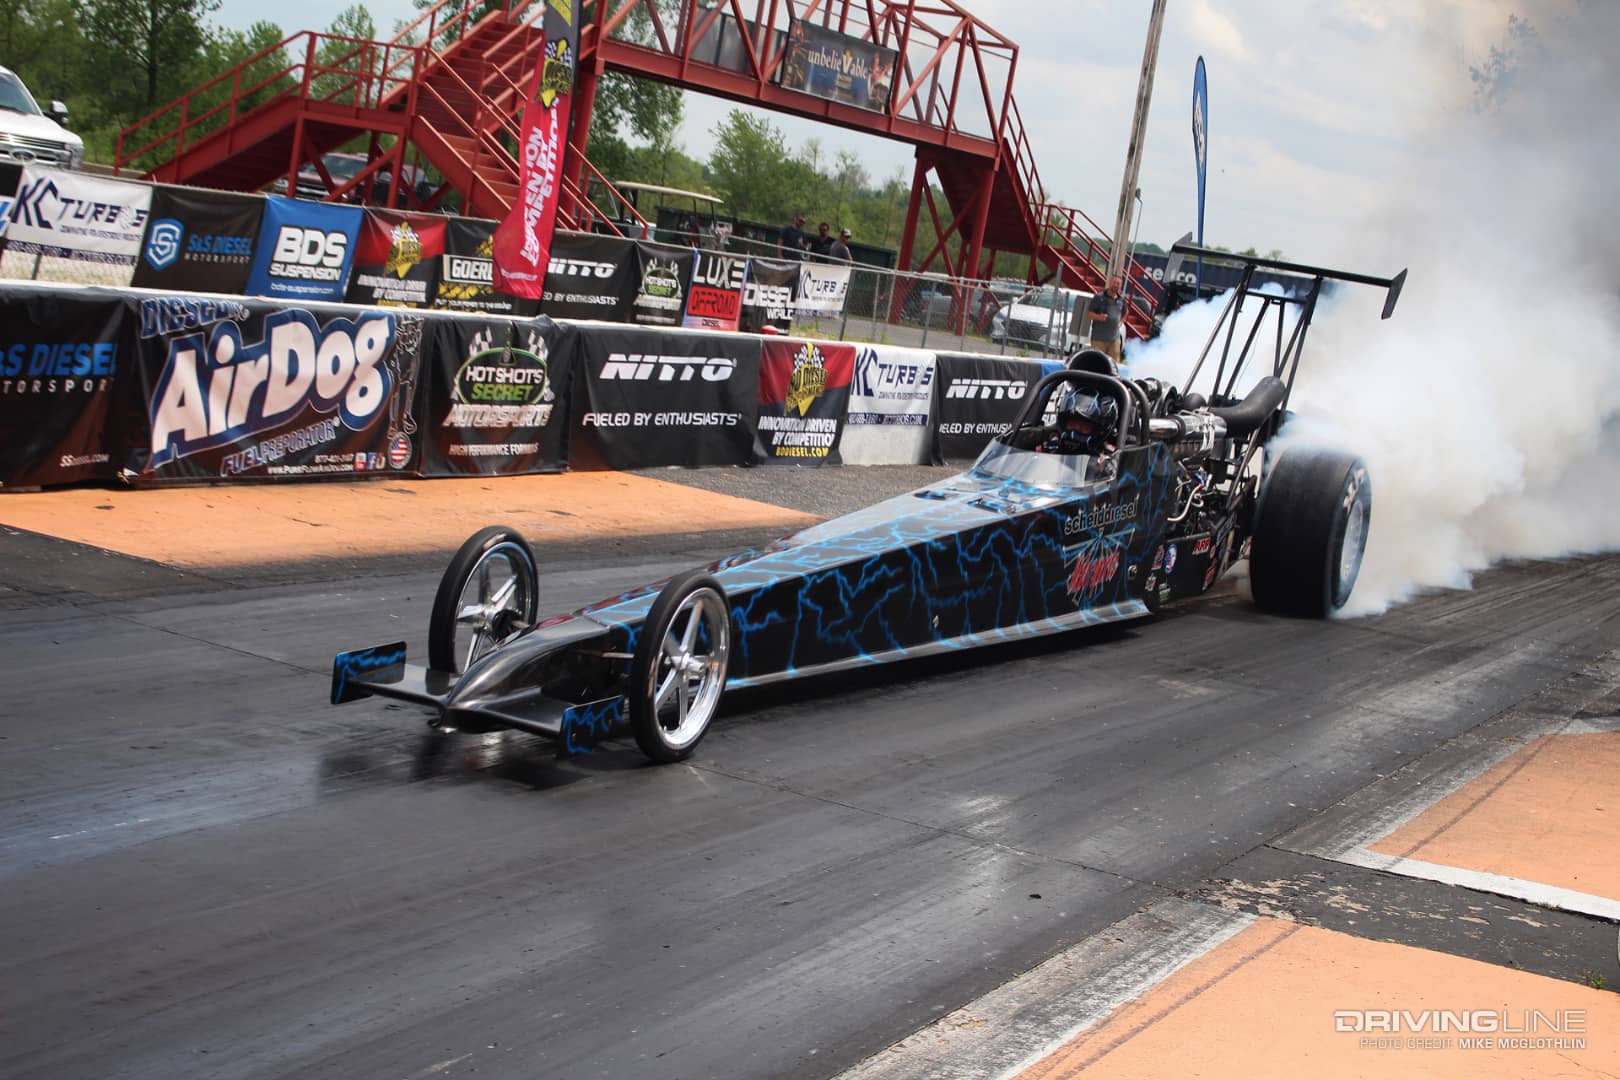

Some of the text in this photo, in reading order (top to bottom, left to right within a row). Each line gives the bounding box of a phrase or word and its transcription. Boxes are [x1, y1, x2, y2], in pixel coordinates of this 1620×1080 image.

[11, 176, 59, 229] KC
[273, 226, 348, 268] BDS
[268, 262, 342, 281] SUSPENSION
[692, 254, 747, 289] LUXE
[691, 288, 738, 316] OFFROAD
[742, 282, 797, 309] DIESEL
[599, 353, 734, 382] NITTO
[152, 314, 391, 456] AirDog
[471, 384, 534, 400] SECRET
[945, 378, 1027, 400] NITTO
[582, 412, 738, 427] FUELED BY ENTHUSIASTS
[805, 418, 837, 433] DRIVEN
[963, 423, 976, 434] BY
[771, 432, 784, 446] BY
